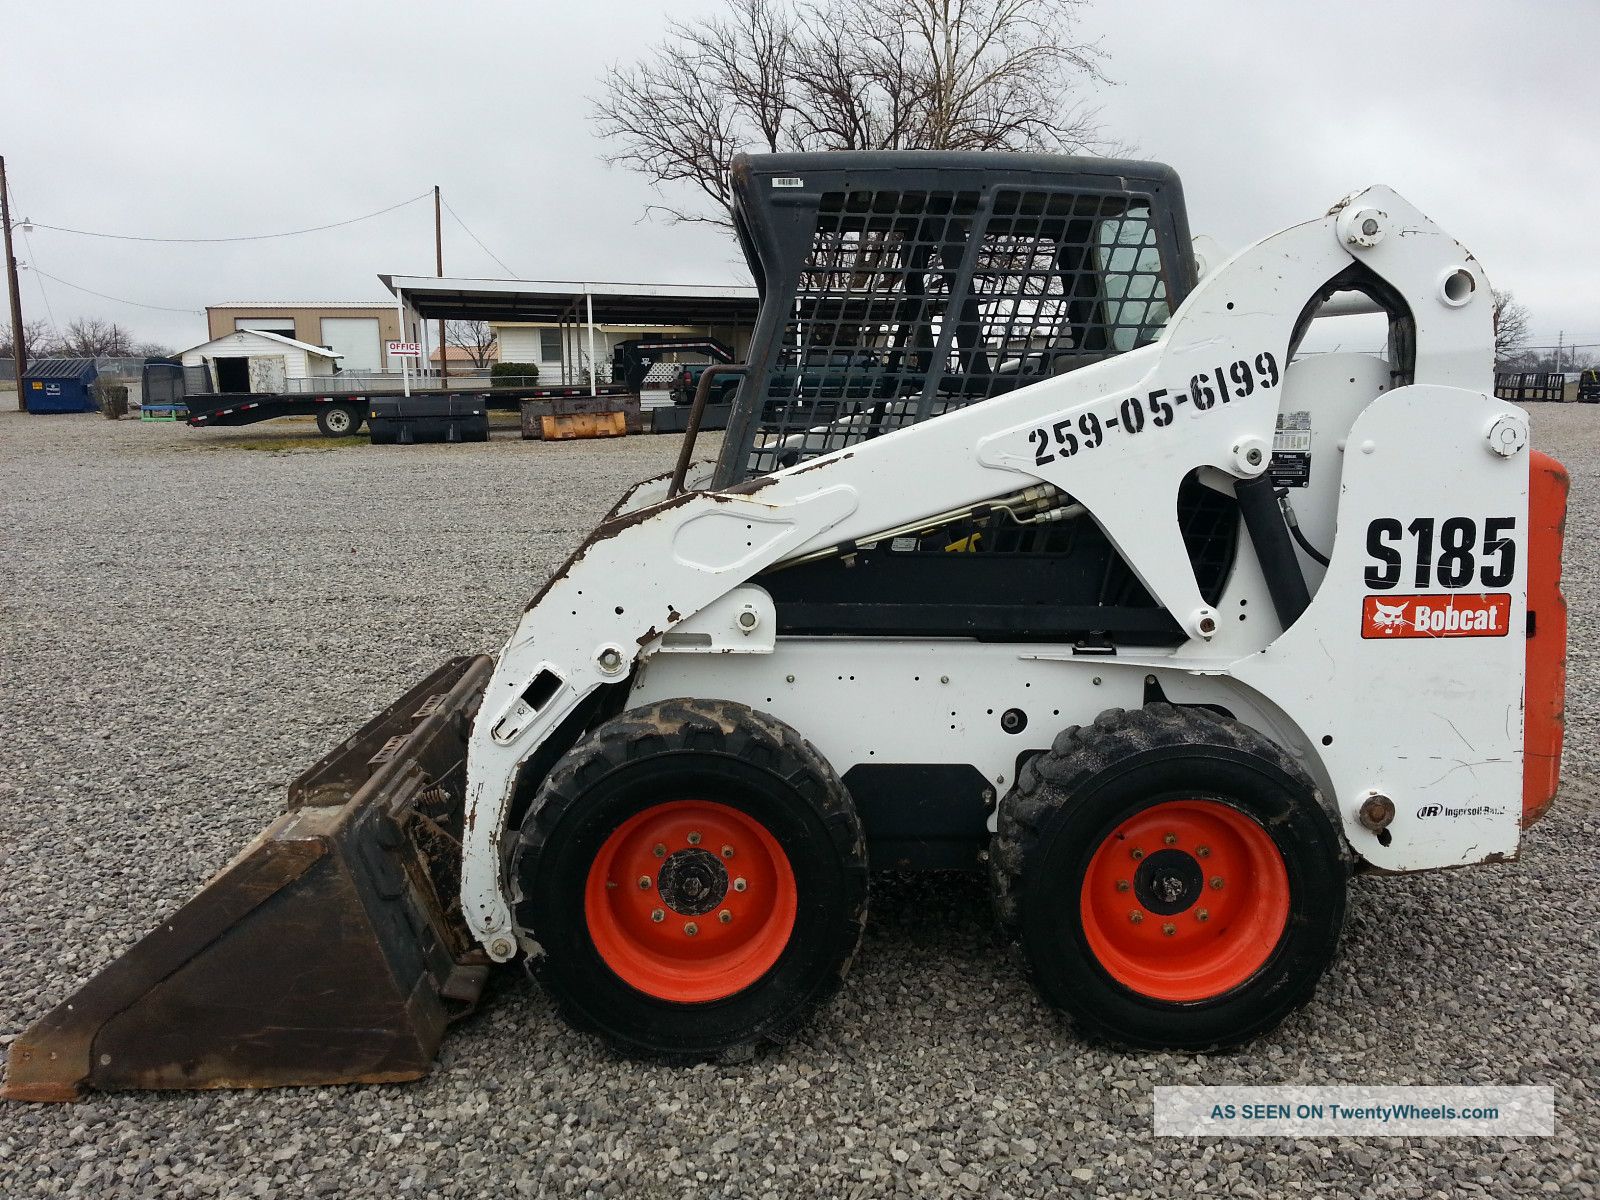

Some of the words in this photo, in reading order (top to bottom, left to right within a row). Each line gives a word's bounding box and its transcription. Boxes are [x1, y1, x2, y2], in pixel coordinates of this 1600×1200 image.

[1028, 352, 1279, 466] 259-05-6199
[1364, 517, 1516, 590] S185
[1414, 605, 1498, 631] Bobcat
